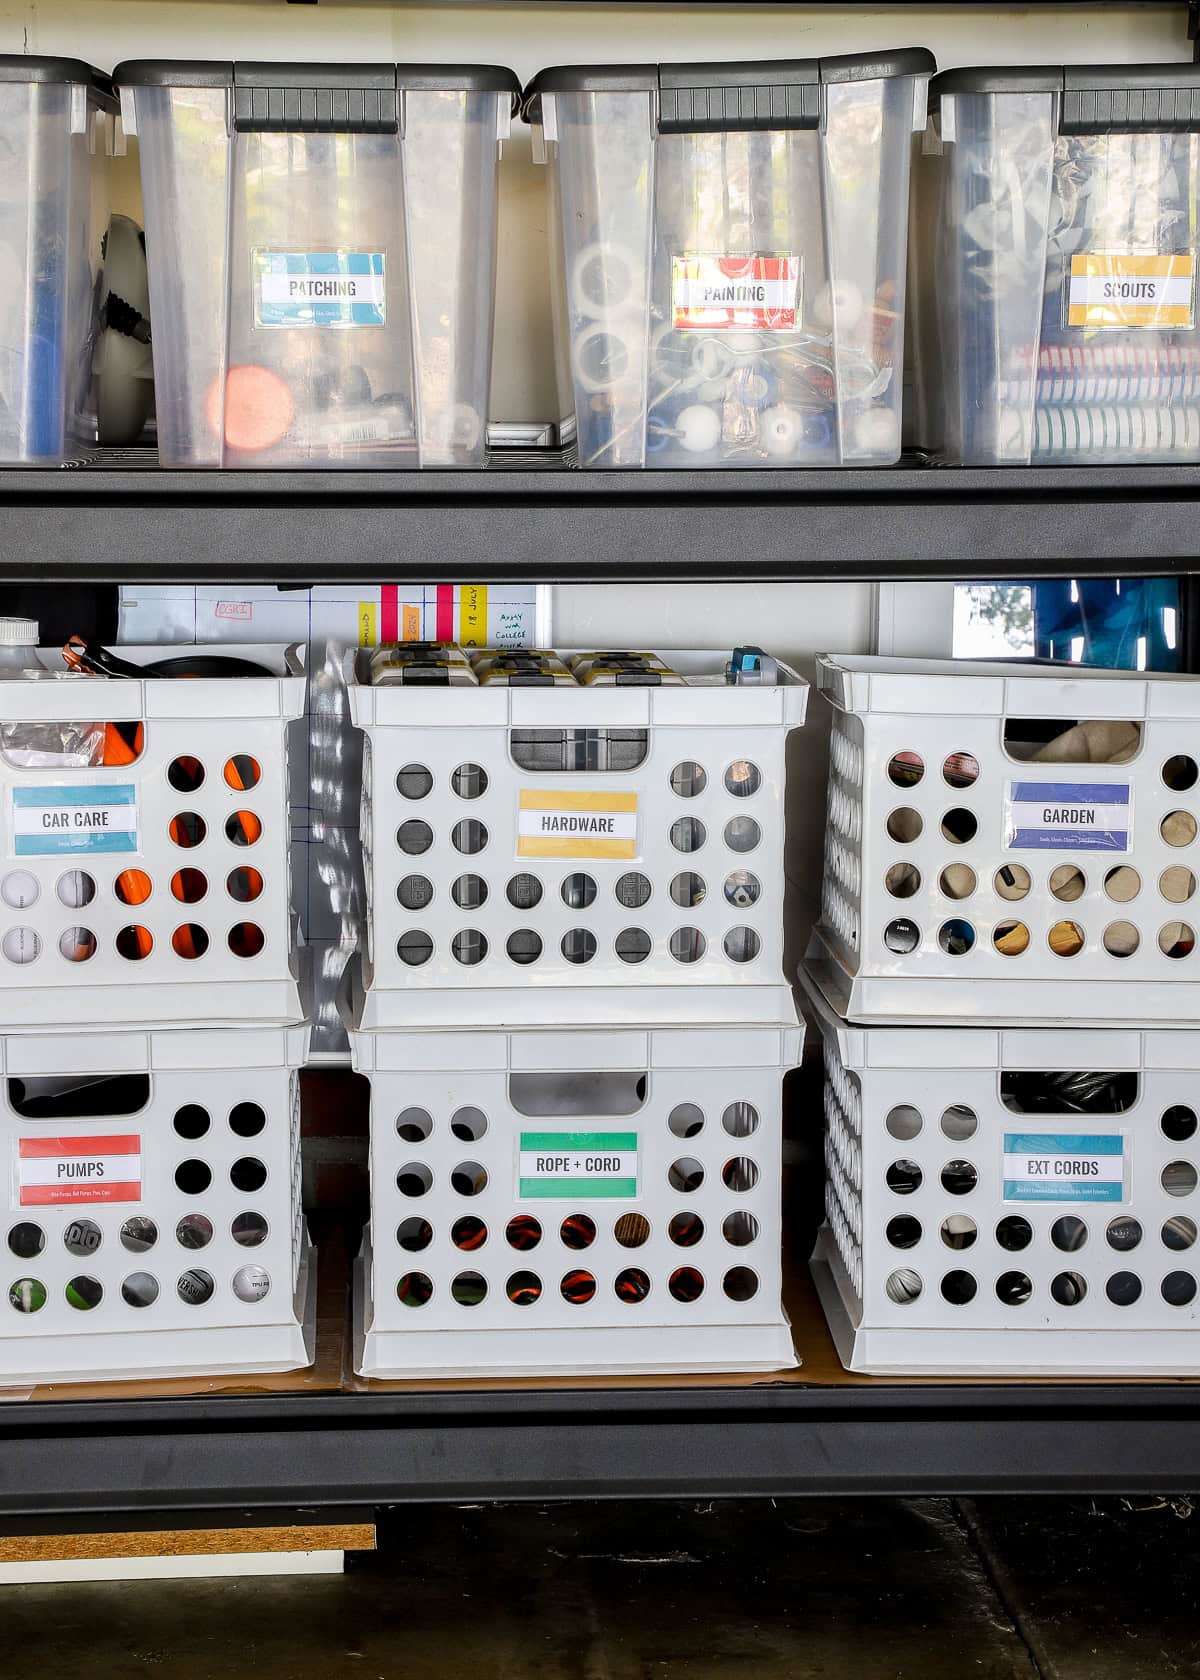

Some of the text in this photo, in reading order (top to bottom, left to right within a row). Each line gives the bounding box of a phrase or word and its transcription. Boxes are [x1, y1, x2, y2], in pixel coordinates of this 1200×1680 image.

[289, 281, 356, 296] PATCHING
[704, 286, 765, 301] PAINTING
[1103, 282, 1156, 298] SCOUTS
[468, 586, 478, 611] JULY
[42, 811, 109, 828] CAR CARE
[1043, 808, 1095, 824] GARDEN
[541, 816, 615, 833] HARDWARE
[57, 1162, 104, 1178] PUMPS
[536, 1157, 621, 1172] ROPE + CORD
[1027, 1160, 1099, 1176] EXT CORDS
